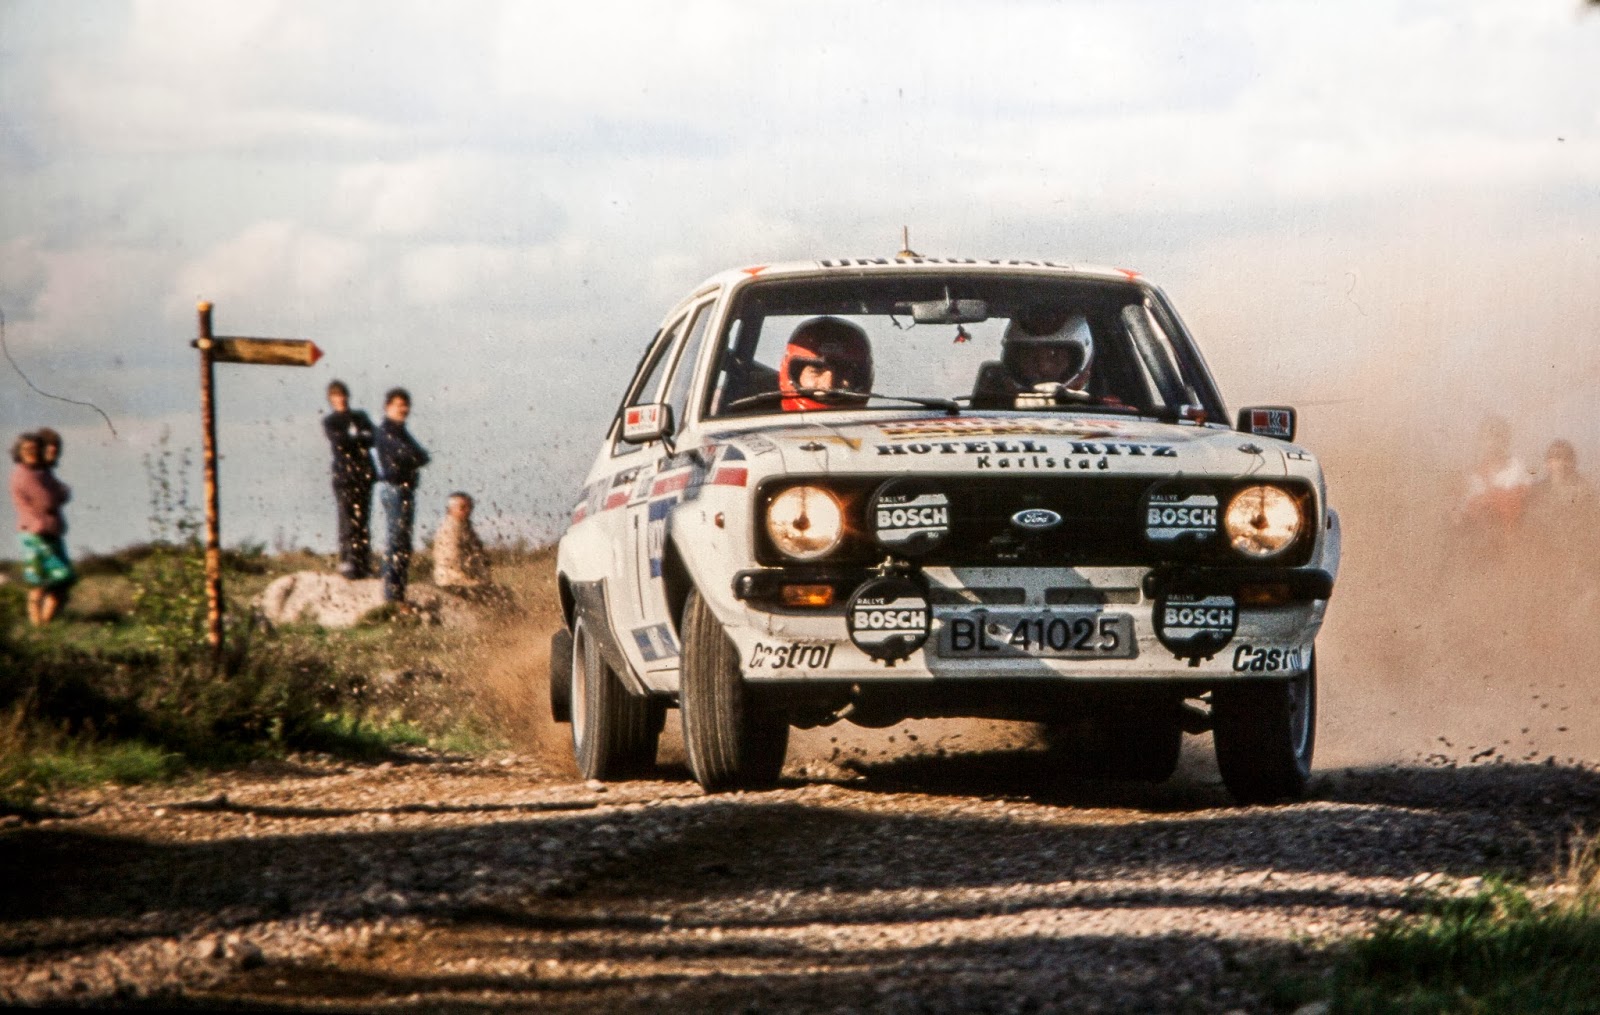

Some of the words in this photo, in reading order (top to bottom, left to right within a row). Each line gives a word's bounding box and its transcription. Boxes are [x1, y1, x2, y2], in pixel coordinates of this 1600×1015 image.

[876, 441, 1048, 455] HOTELL
[1069, 441, 1178, 457] RITZ
[977, 455, 1110, 469] Karlstad
[877, 507, 948, 528] BOSCH
[1023, 512, 1049, 524] Ford
[1147, 507, 1217, 526] BOSCH
[854, 610, 926, 629] BOSCH
[1164, 607, 1233, 626] BOSCH
[951, 615, 1000, 651] BL
[1008, 617, 1120, 651] 41025
